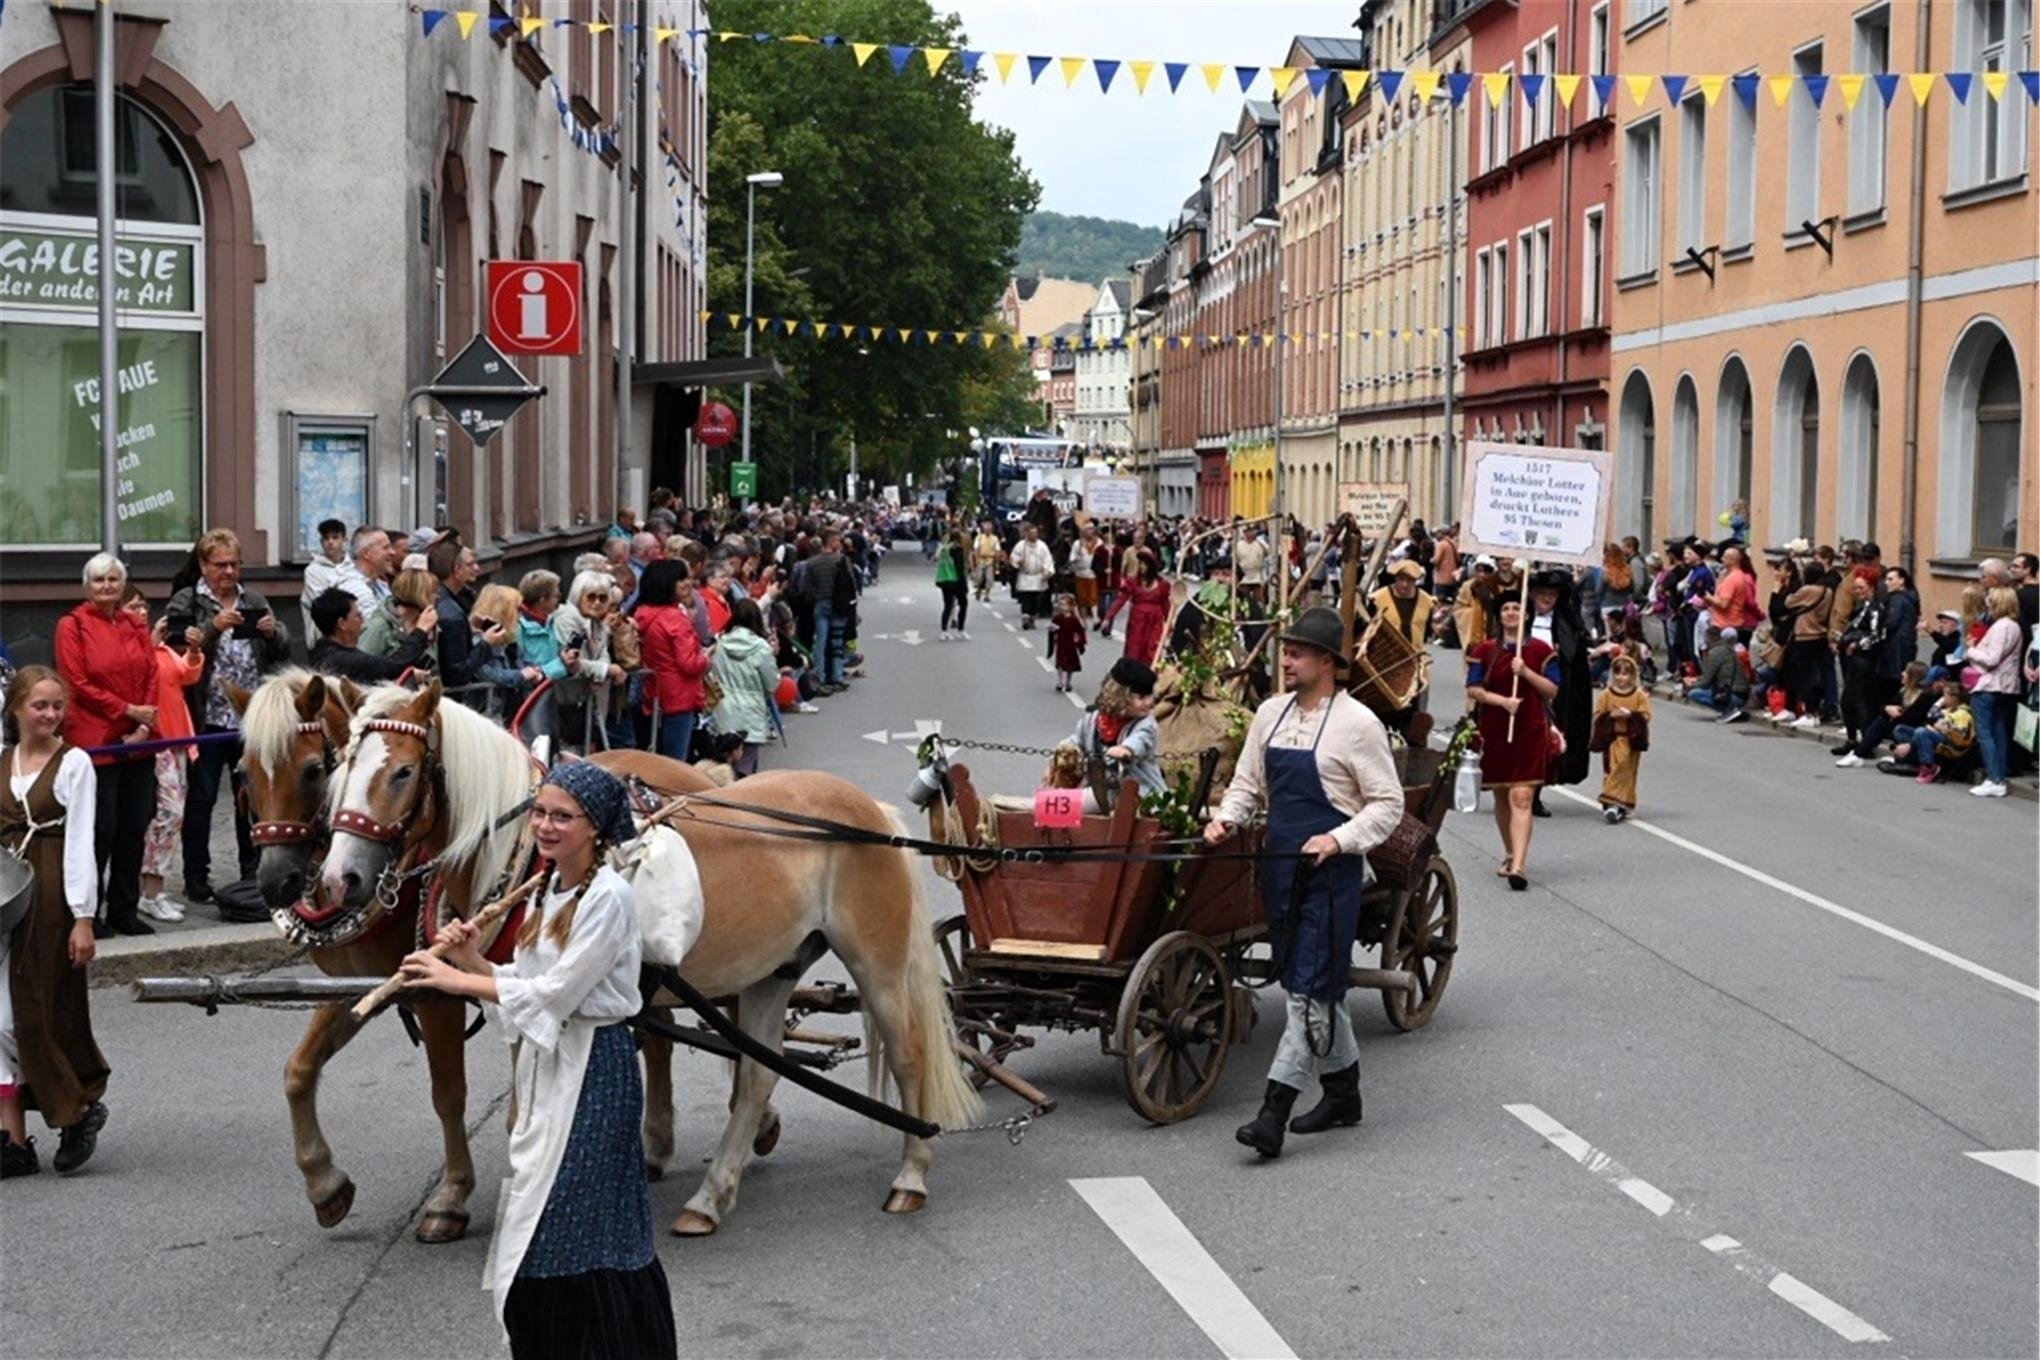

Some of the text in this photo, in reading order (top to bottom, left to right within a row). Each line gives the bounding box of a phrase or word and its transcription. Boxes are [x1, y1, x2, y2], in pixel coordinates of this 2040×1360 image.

[0, 238, 178, 280] GALERIE
[0, 273, 174, 306] der anden Art
[118, 360, 158, 394] AUE
[1525, 463, 1552, 474] 1517
[1492, 472, 1586, 491] Melchior Lotter
[1490, 487, 1502, 496] in
[1504, 487, 1528, 499] Aue
[118, 489, 175, 521] Daumen
[1532, 503, 1580, 518] Luthers
[1519, 514, 1563, 529] Thesen
[1045, 796, 1071, 815] H3
